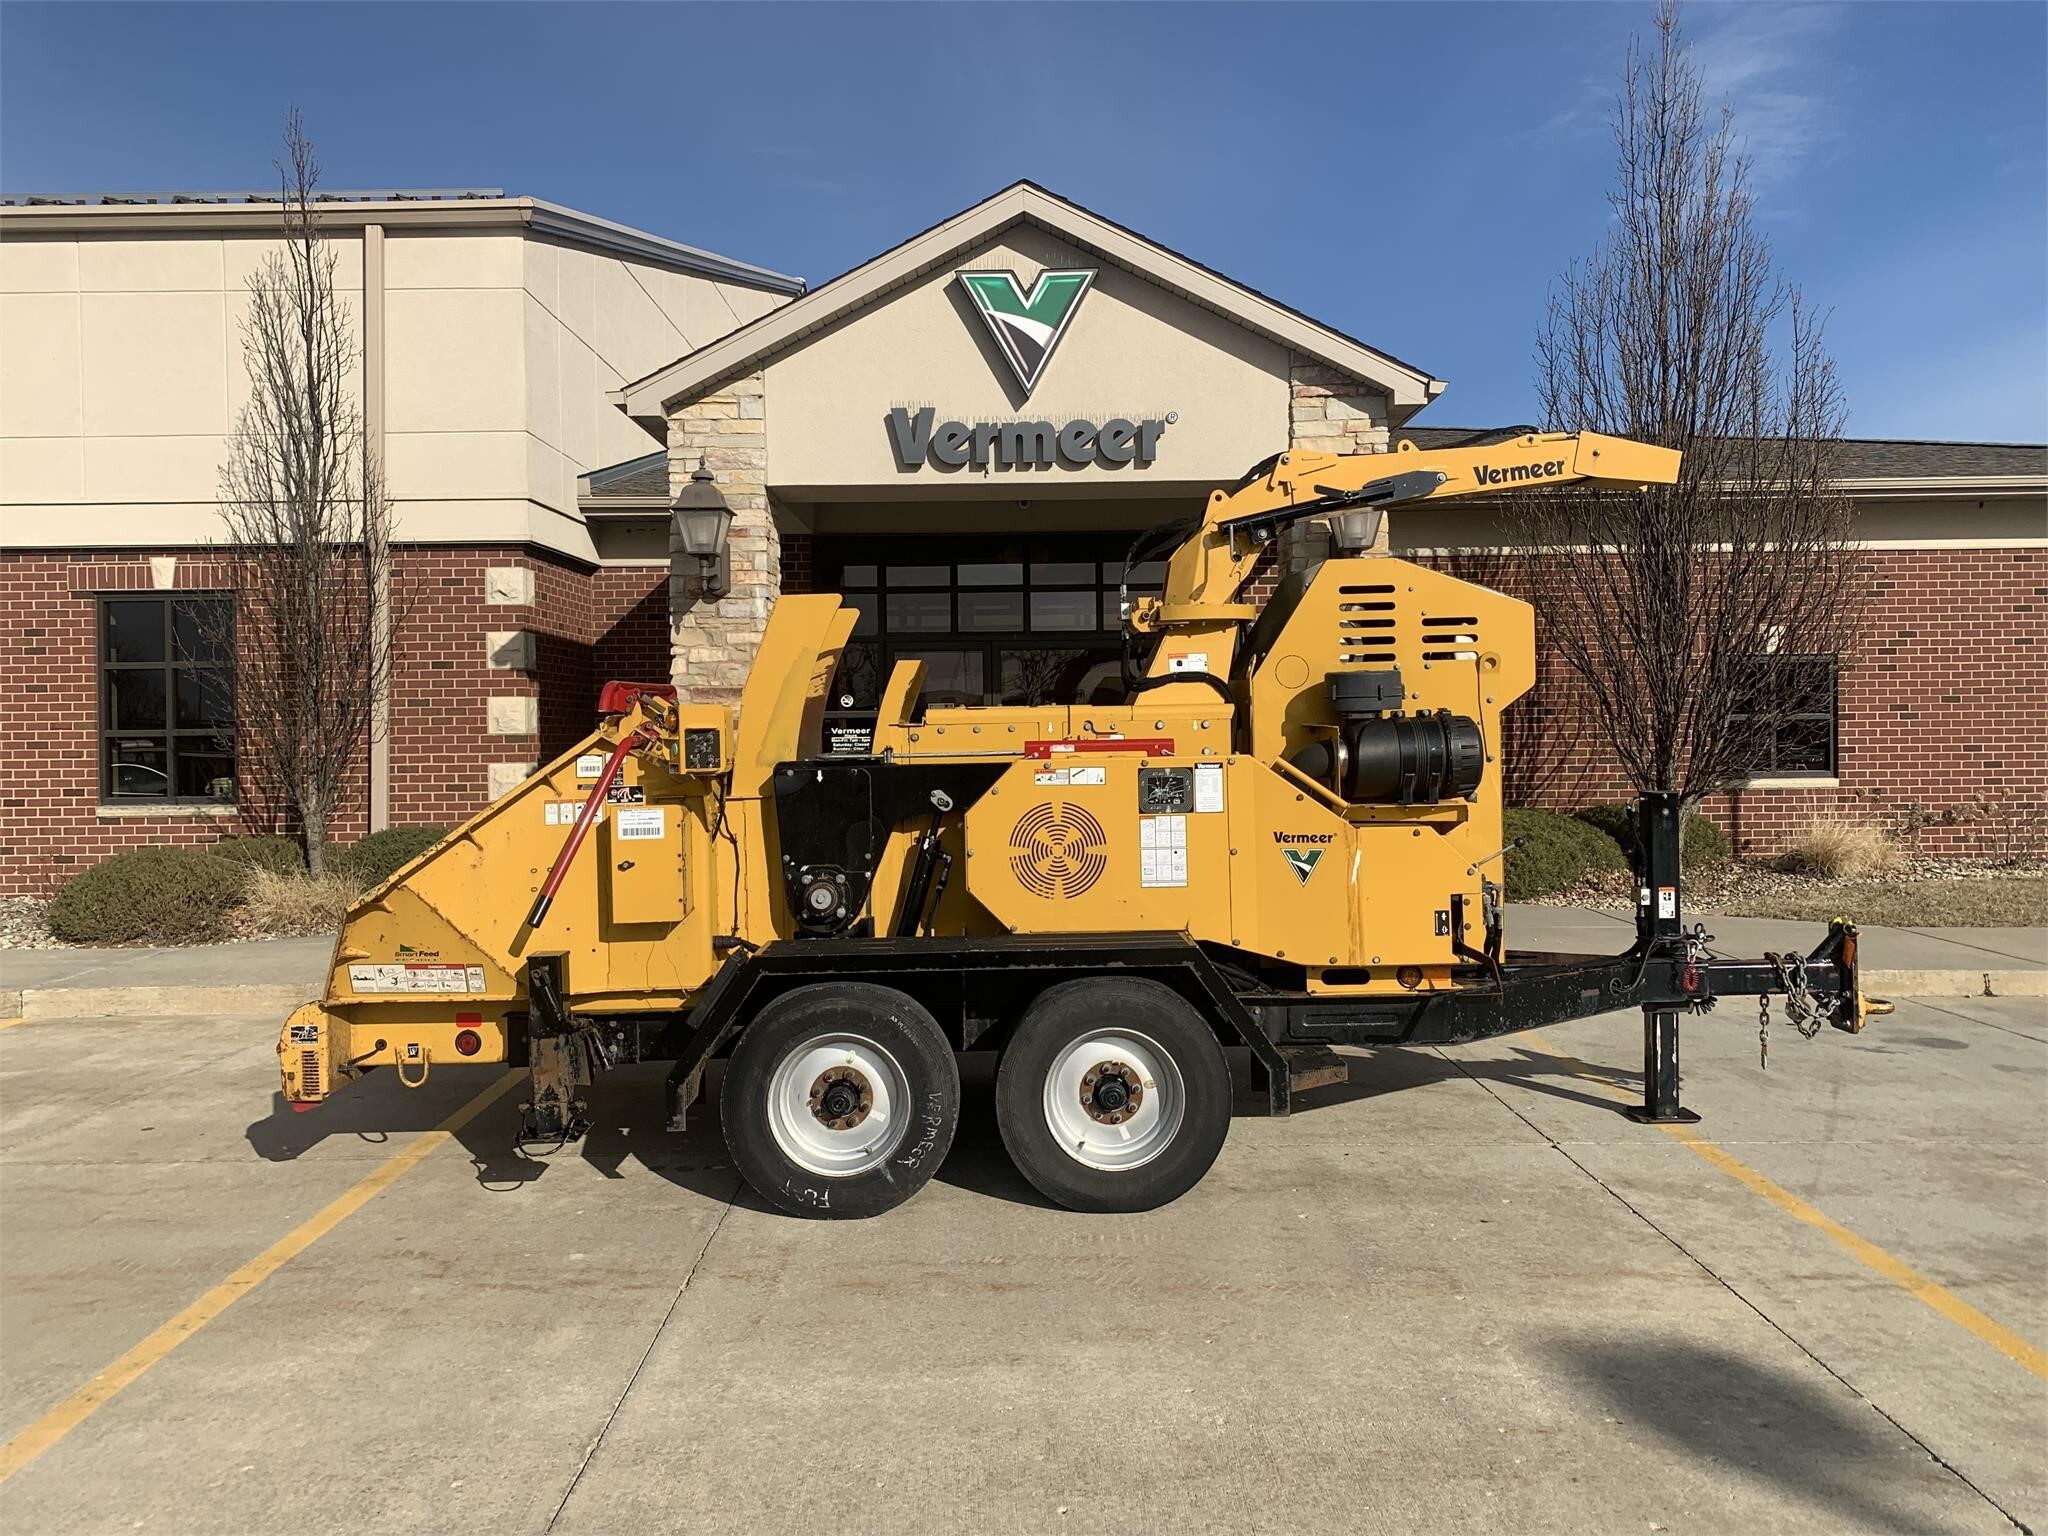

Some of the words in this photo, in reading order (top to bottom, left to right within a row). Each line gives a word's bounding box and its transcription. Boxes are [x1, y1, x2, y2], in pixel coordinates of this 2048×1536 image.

[1473, 459, 1565, 486] Vermeer
[831, 727, 871, 735] Vermeer
[1273, 831, 1334, 844] Vermeer
